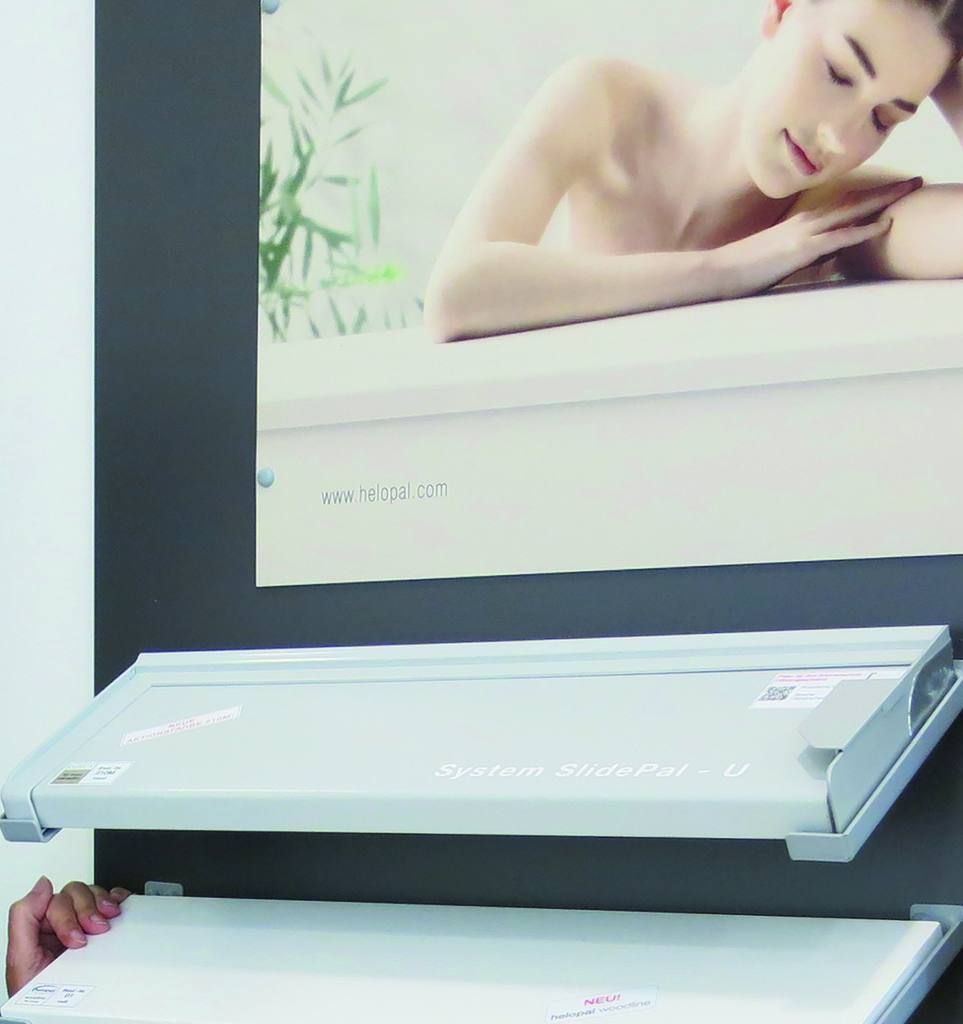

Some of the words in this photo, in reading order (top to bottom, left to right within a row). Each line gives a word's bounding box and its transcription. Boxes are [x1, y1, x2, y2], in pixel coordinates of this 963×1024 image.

[321, 481, 448, 504] www.helopal.com
[434, 763, 546, 780] System
[555, 763, 689, 778] SlidePal
[722, 763, 751, 778] U
[583, 994, 621, 1006] NEU!
[550, 1008, 596, 1021] helopal
[599, 1000, 651, 1013] woodline
